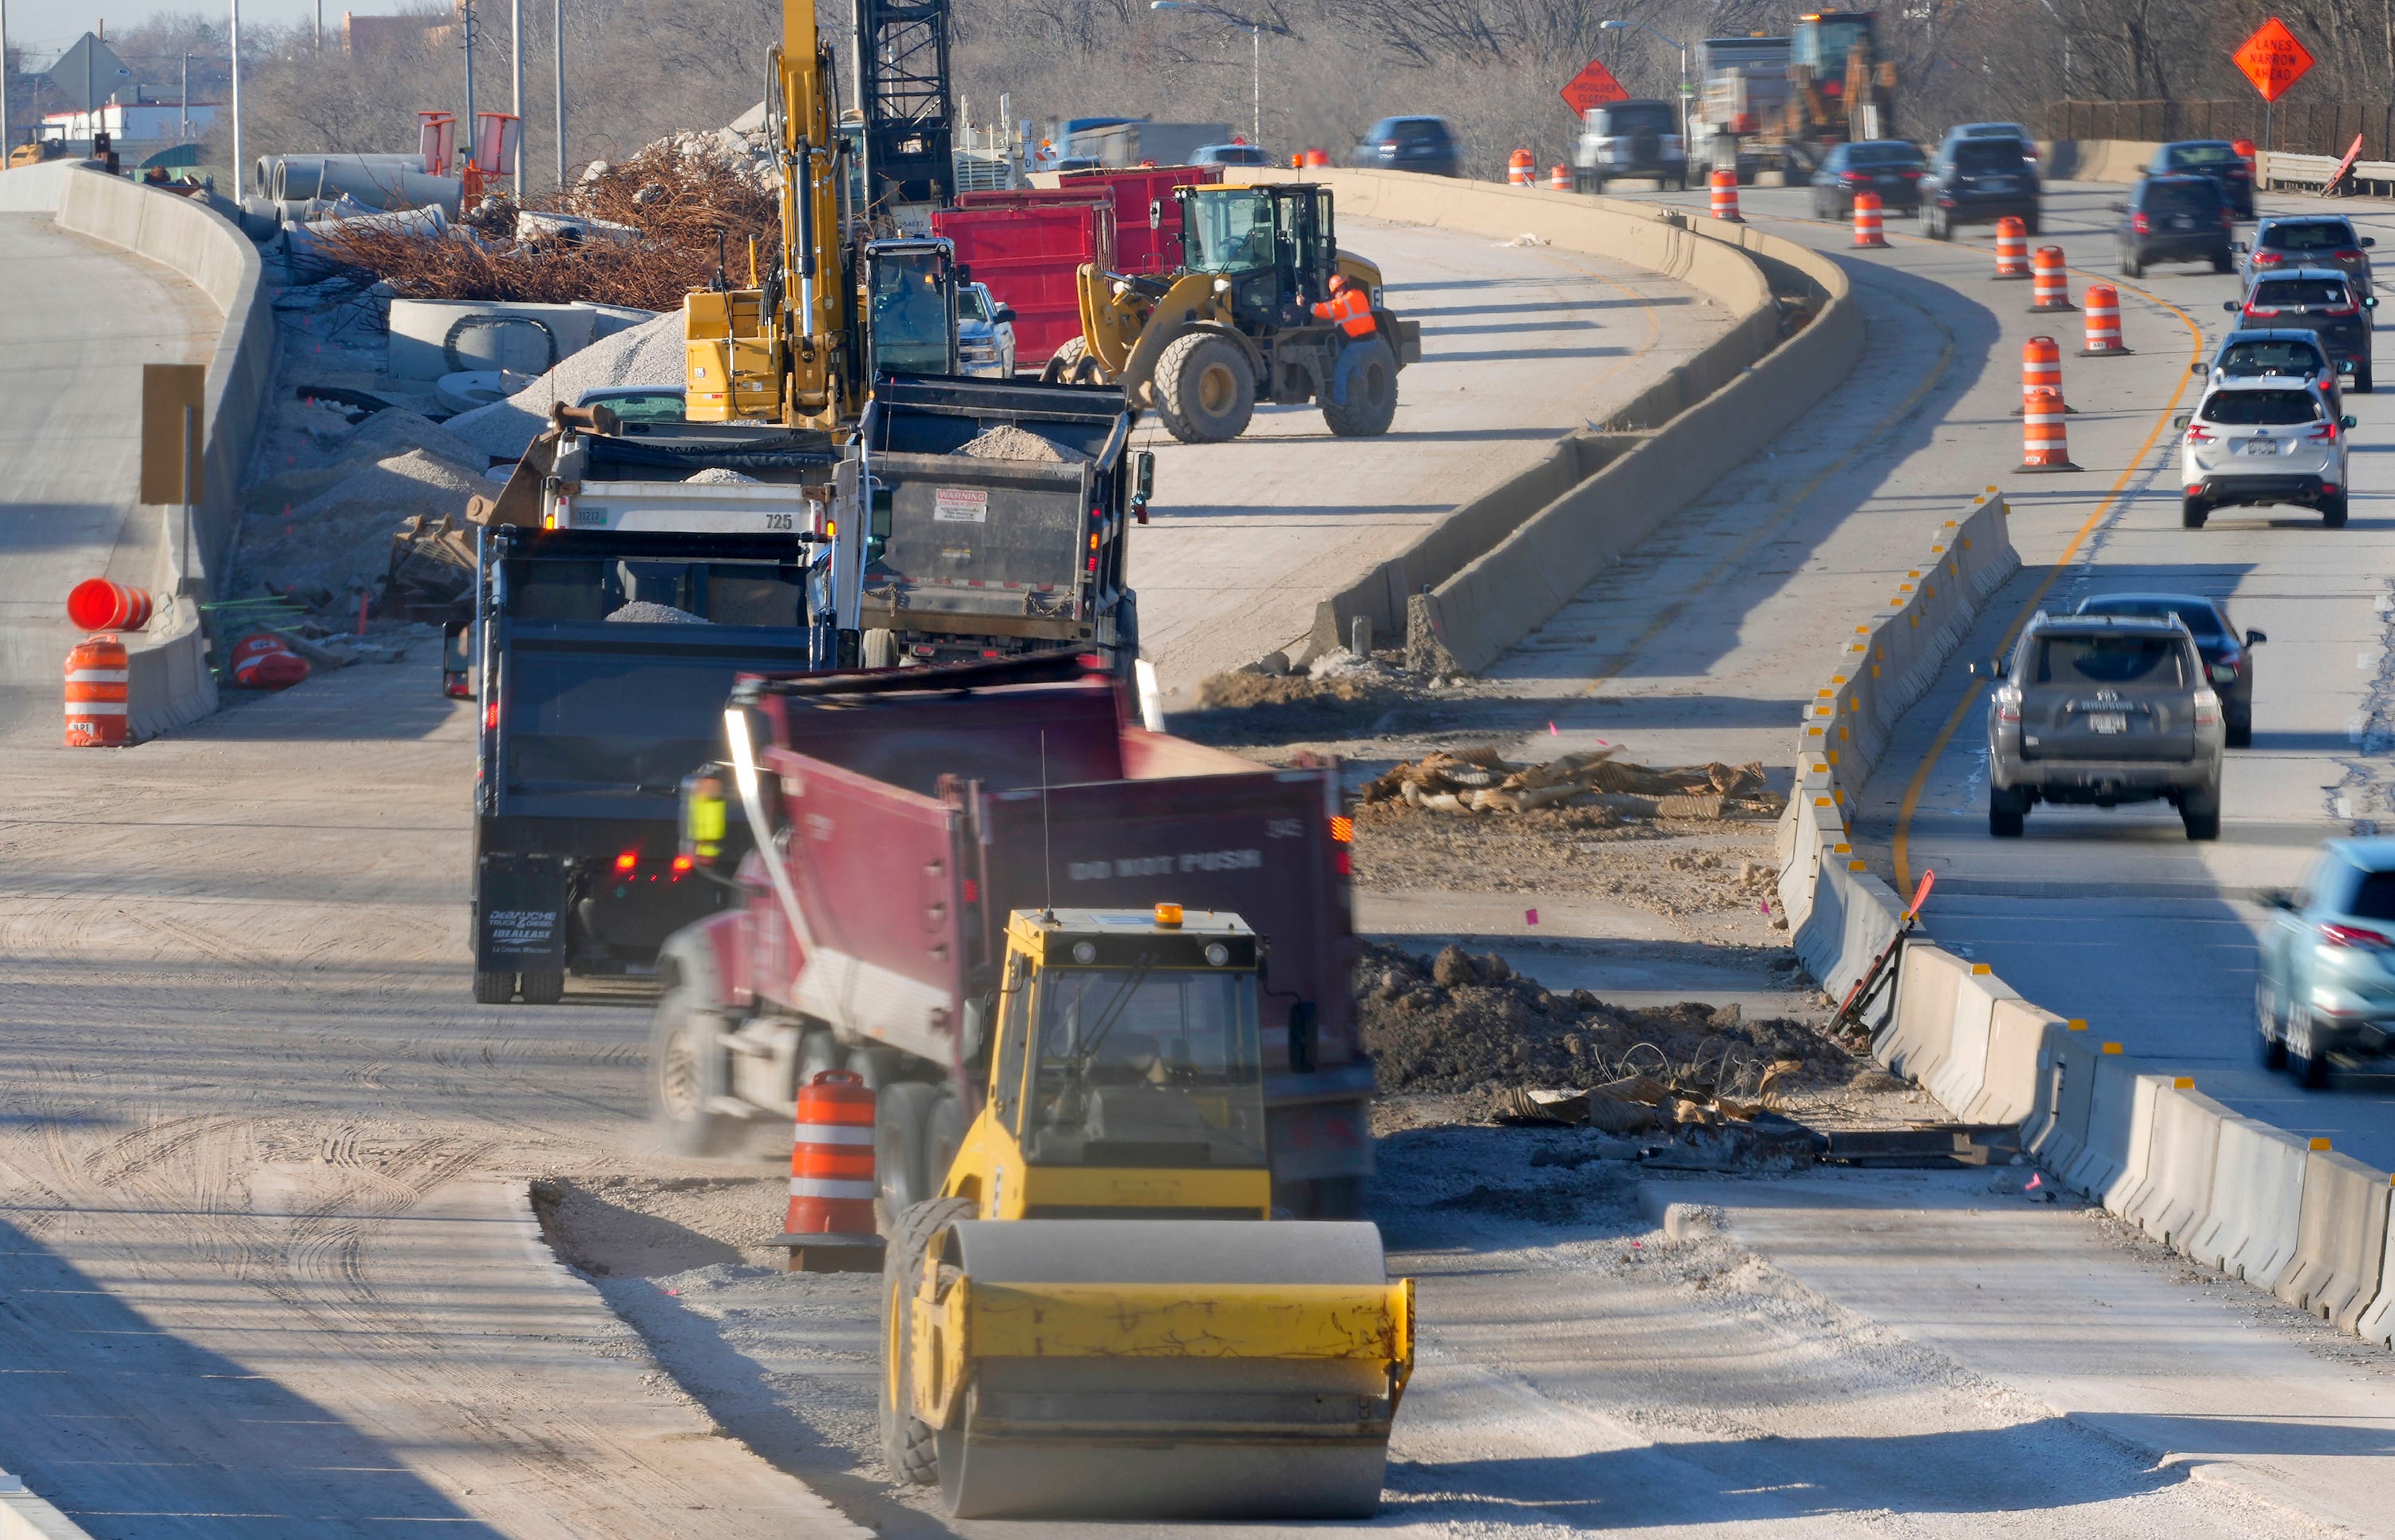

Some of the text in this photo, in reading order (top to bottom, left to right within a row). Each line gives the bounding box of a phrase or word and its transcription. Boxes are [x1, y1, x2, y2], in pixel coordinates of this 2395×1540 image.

[2255, 39, 2292, 51] LANES
[2250, 53, 2297, 65] NARROW
[2254, 68, 2291, 81] AHEAD
[1573, 82, 1617, 93] SHOULDER
[1578, 94, 1610, 103] CLOSED
[939, 490, 985, 501] WARNING
[766, 513, 793, 529] 725
[1068, 849, 1262, 881] DO NOT PUSH
[492, 929, 552, 938] IDEALEASE
